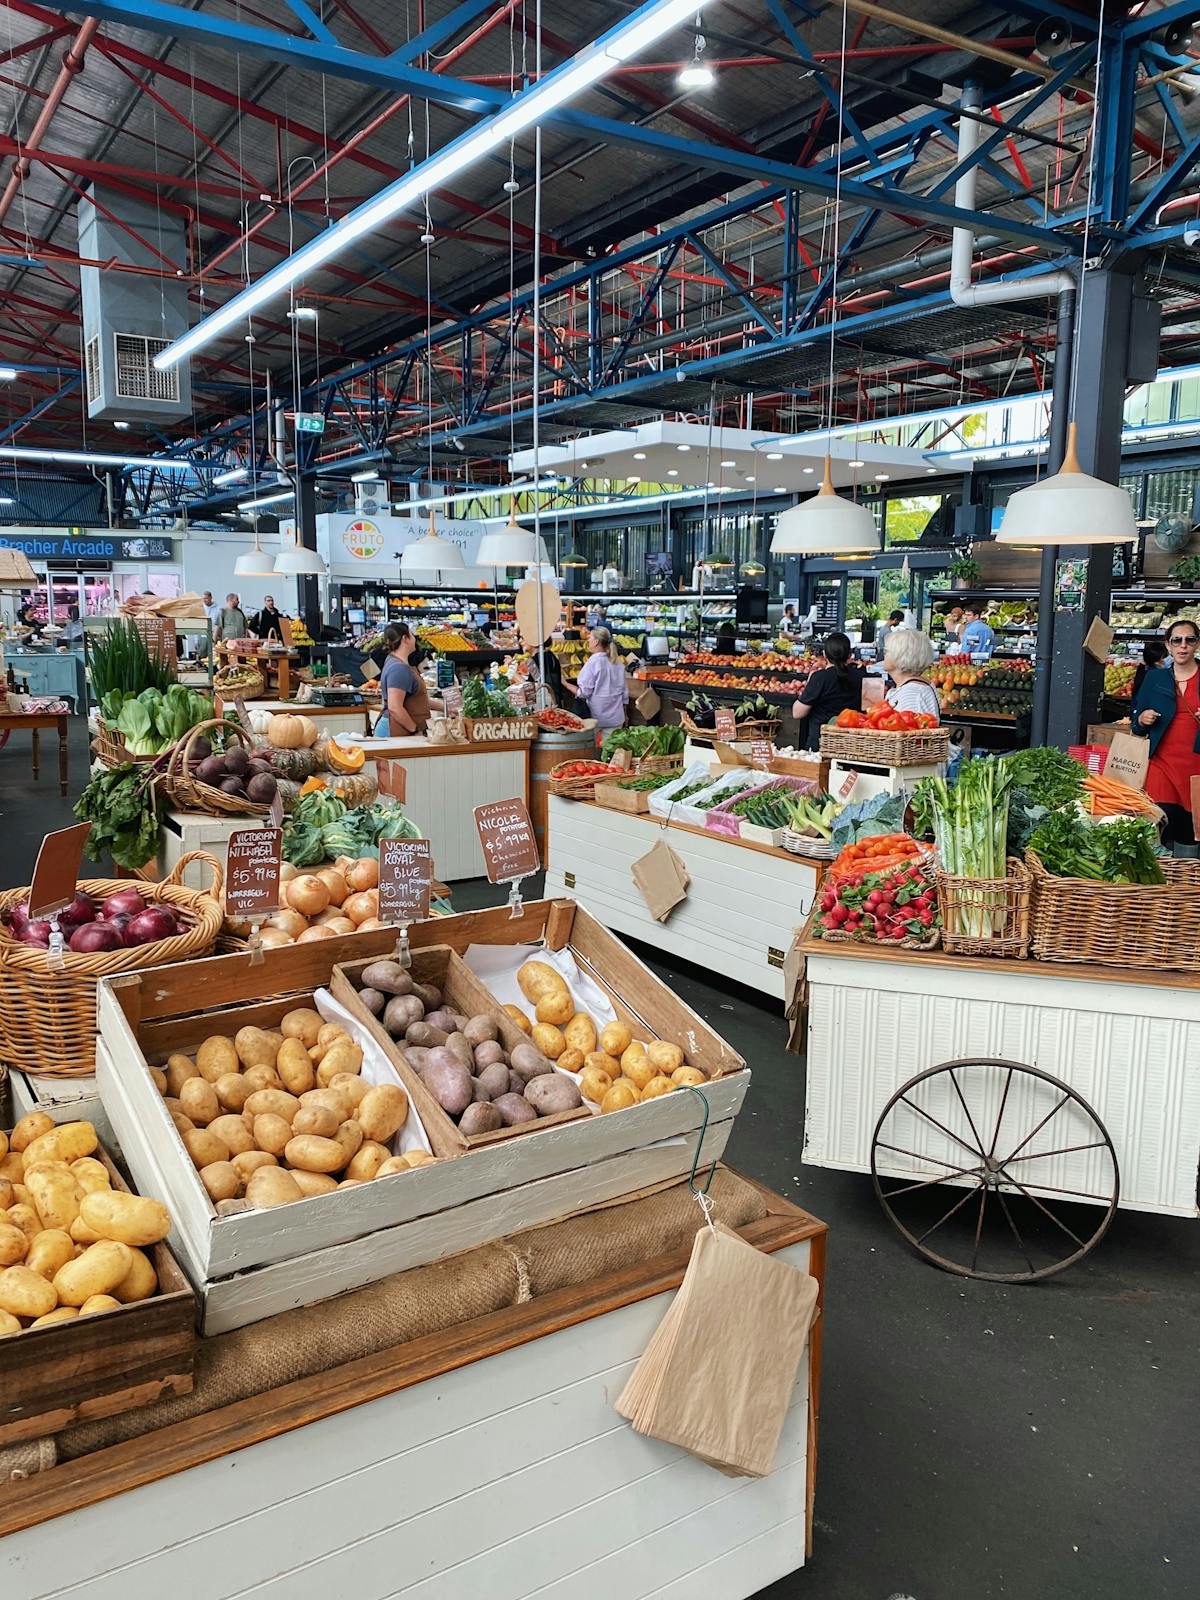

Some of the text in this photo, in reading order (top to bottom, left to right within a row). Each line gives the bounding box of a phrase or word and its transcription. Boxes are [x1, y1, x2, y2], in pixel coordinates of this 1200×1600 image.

[342, 533, 385, 545] FRUTO
[61, 539, 114, 556] Arcade
[472, 721, 534, 740] ORGANIC
[1112, 756, 1141, 768] MARCUS
[1115, 765, 1137, 774] BURTON
[479, 814, 521, 832] NICOLA
[237, 831, 277, 842] VICTORIAN
[385, 841, 429, 853] VICTORIAN
[384, 852, 416, 866] ROYAL
[394, 866, 420, 880] BLUE
[237, 899, 255, 909] VIC
[394, 910, 409, 919] VIC
